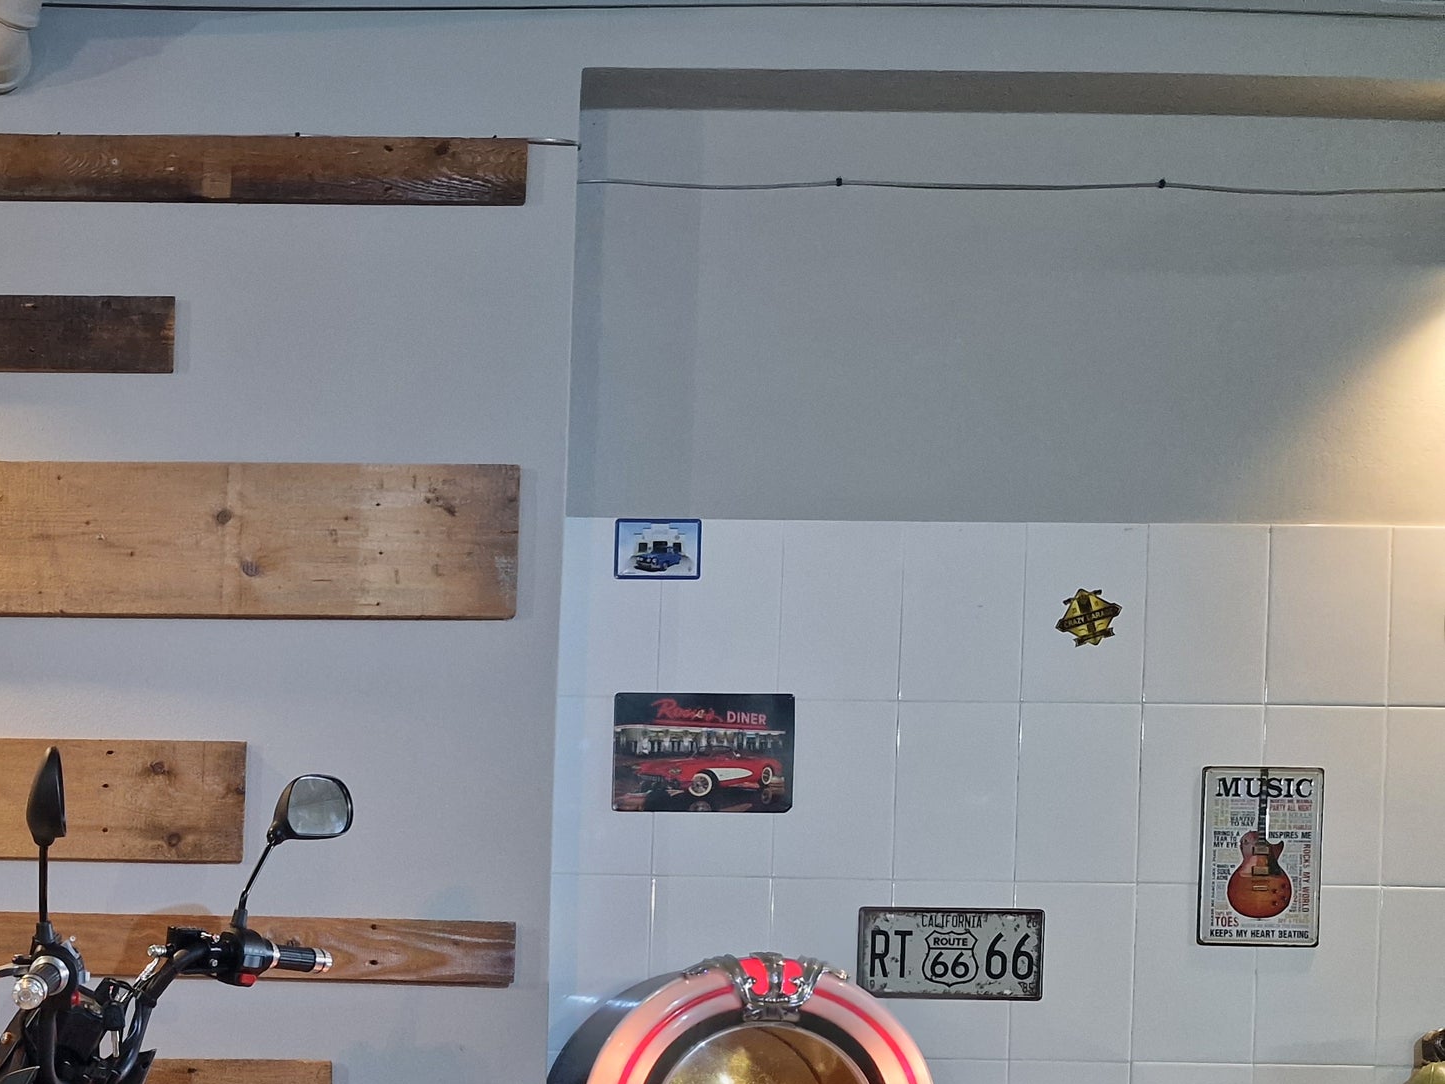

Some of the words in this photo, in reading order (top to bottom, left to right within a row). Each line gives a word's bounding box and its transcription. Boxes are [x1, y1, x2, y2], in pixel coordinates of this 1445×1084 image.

[726, 711, 767, 725] DINER
[1215, 778, 1313, 798] MUSIC
[1268, 831, 1298, 839] INSPIRES
[1301, 832, 1312, 840] ME
[1302, 844, 1311, 868] ROCKS
[1302, 872, 1310, 883] MY
[1302, 887, 1311, 912] WORLD
[921, 914, 983, 929] CALIFORNIA
[1215, 916, 1239, 927] TOES
[1210, 929, 1233, 938] KEEPS
[1236, 930, 1248, 938] MY
[1251, 930, 1276, 938] HEART
[1278, 931, 1309, 939] BEATING
[933, 938, 969, 947] ROUTE
[869, 930, 913, 978] RT
[985, 932, 1034, 980] 66
[930, 951, 970, 979] 66
